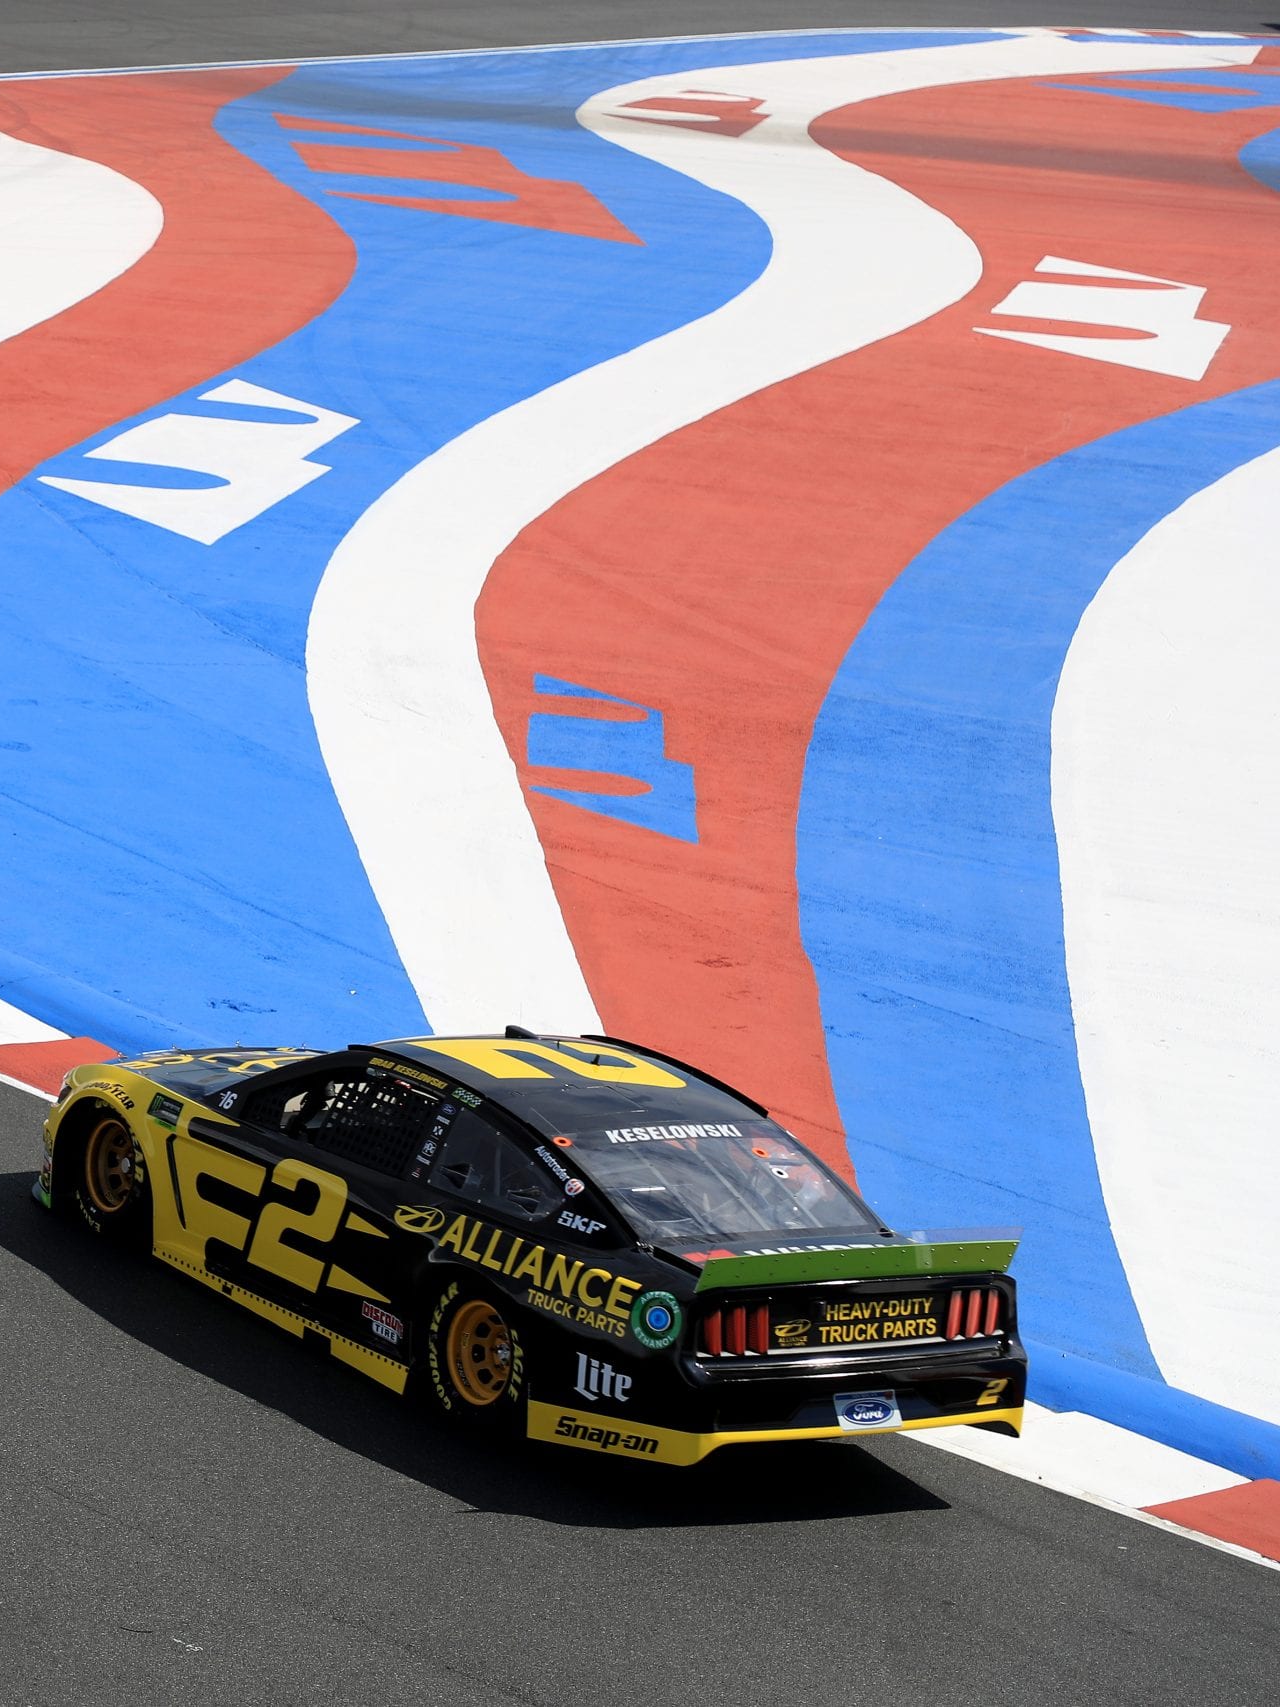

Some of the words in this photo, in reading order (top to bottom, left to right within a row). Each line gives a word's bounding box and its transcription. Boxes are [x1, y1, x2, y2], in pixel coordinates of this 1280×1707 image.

[605, 1123, 743, 1145] KESELOWSKI
[534, 1145, 570, 1181] Autotrader
[246, 1158, 349, 1294] 2
[557, 1210, 607, 1234] SKF
[438, 1214, 643, 1320] ALLIANCE
[527, 1288, 579, 1319] TRUCK
[575, 1307, 627, 1338] PARTS
[826, 1297, 933, 1321] HEAVY-DUTY
[374, 1322, 397, 1341] TIRE
[633, 1326, 675, 1349] ETHANOL
[819, 1322, 878, 1344] TRUCK
[882, 1317, 937, 1339] PARTS
[574, 1351, 633, 1402] Lite
[976, 1378, 1008, 1406] 2
[554, 1415, 660, 1455] Snap-on
